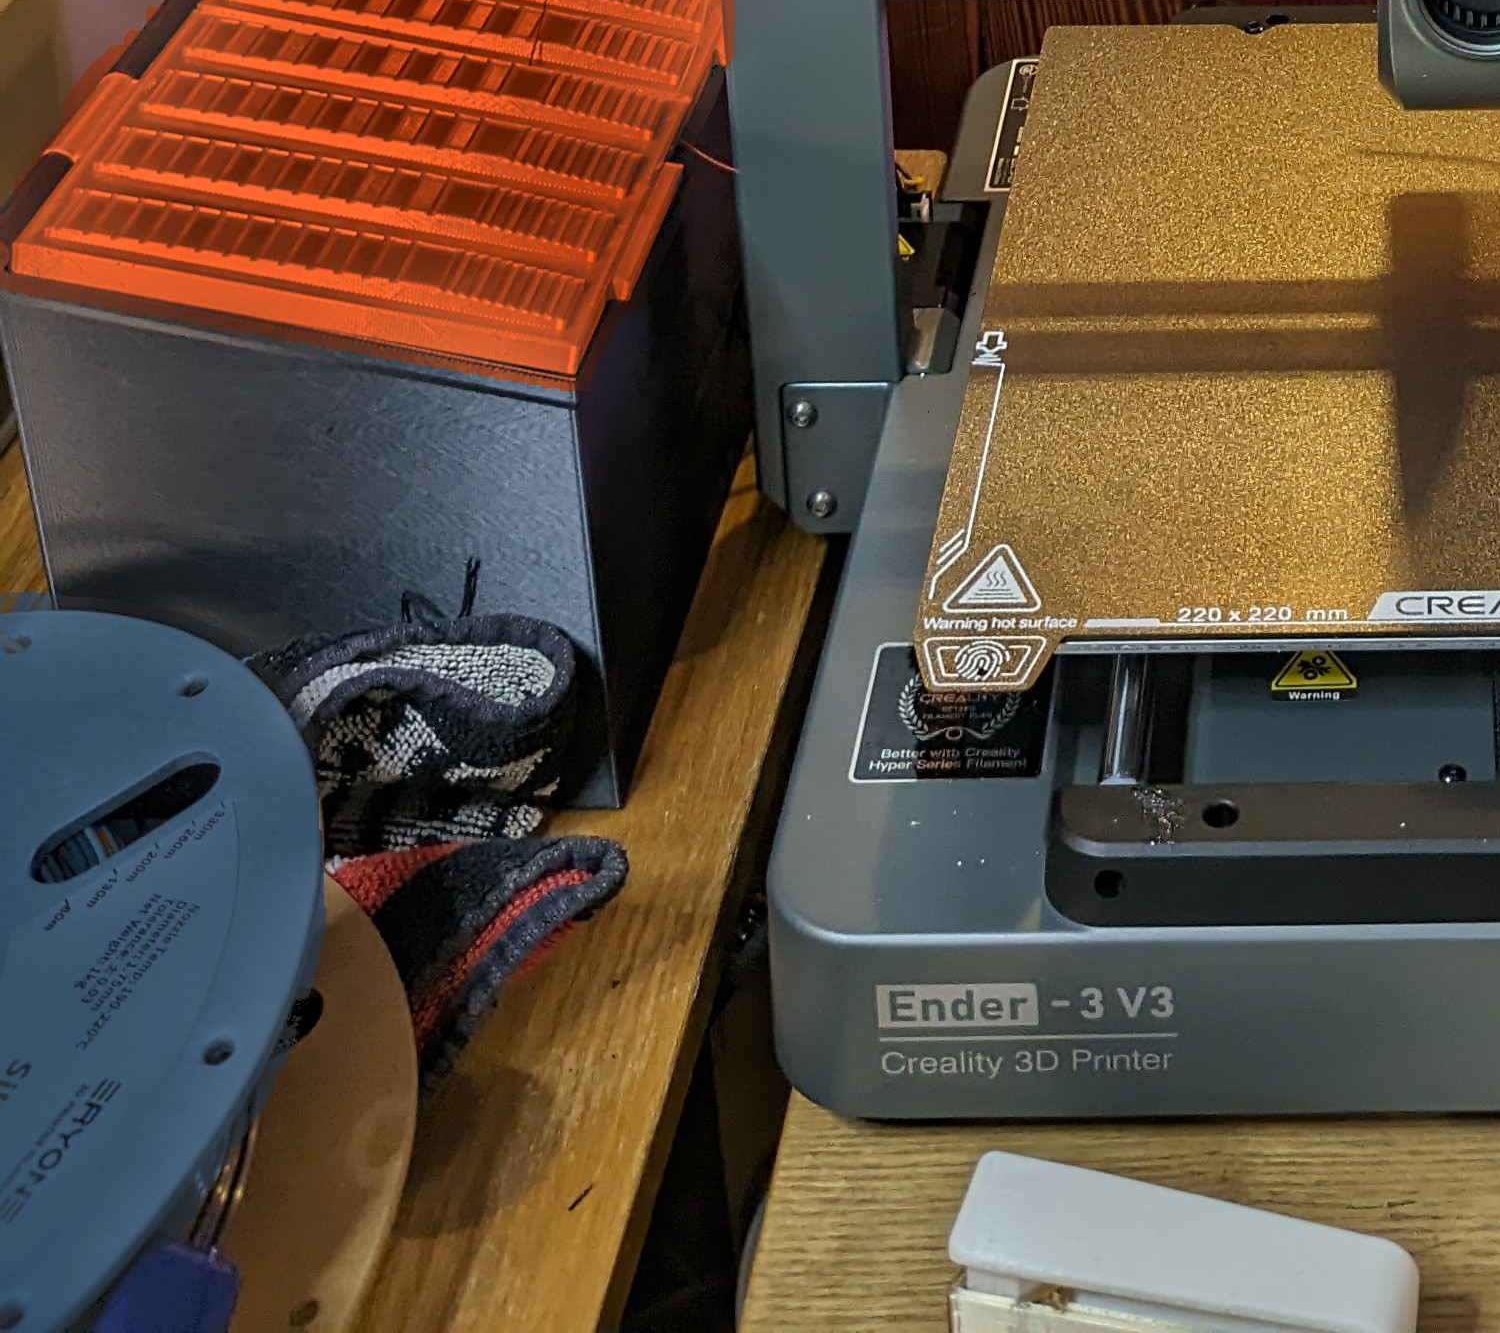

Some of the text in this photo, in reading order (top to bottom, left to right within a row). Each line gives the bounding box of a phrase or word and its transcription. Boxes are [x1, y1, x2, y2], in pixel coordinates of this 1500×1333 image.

[1178, 607, 1348, 622] 220 x 220 mm
[923, 615, 1077, 631] Warning hot surface
[919, 693, 1000, 703] CREALITY
[1289, 691, 1339, 700] Warning
[881, 748, 1020, 759] Better with Creality
[869, 758, 1027, 772] Hyper Series Filament
[127, 851, 157, 883] 200m
[888, 989, 1028, 1022] Ender
[1116, 986, 1176, 1018] V3
[881, 1049, 1173, 1079] Creality 3D Printer
